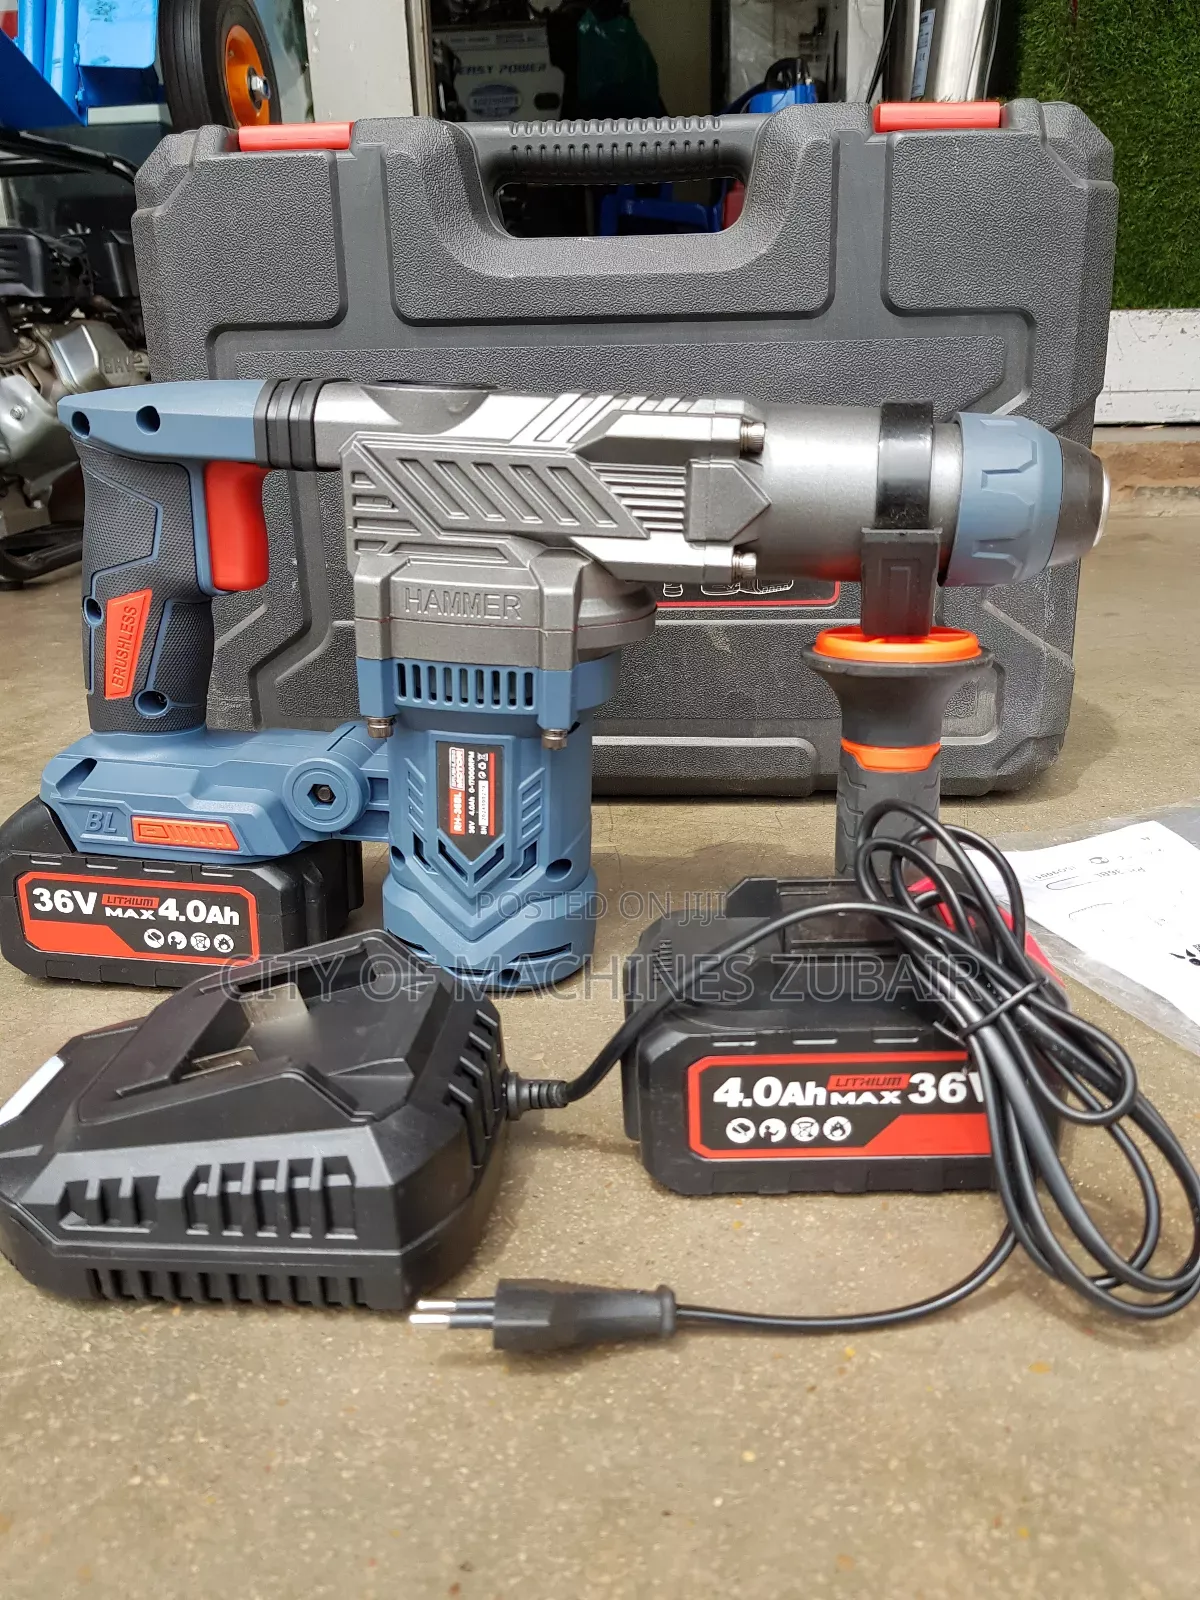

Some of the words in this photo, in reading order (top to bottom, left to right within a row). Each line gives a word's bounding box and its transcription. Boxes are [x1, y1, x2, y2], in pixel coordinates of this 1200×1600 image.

[405, 587, 522, 620] HAMMER
[111, 606, 138, 689] BRUSHLESS
[85, 811, 118, 834] BL
[32, 888, 98, 915] 36V
[158, 898, 240, 926] 4.0Ah
[105, 907, 156, 921] MAX
[713, 1076, 828, 1107] 4.0Ah
[830, 1091, 902, 1105] MAX
